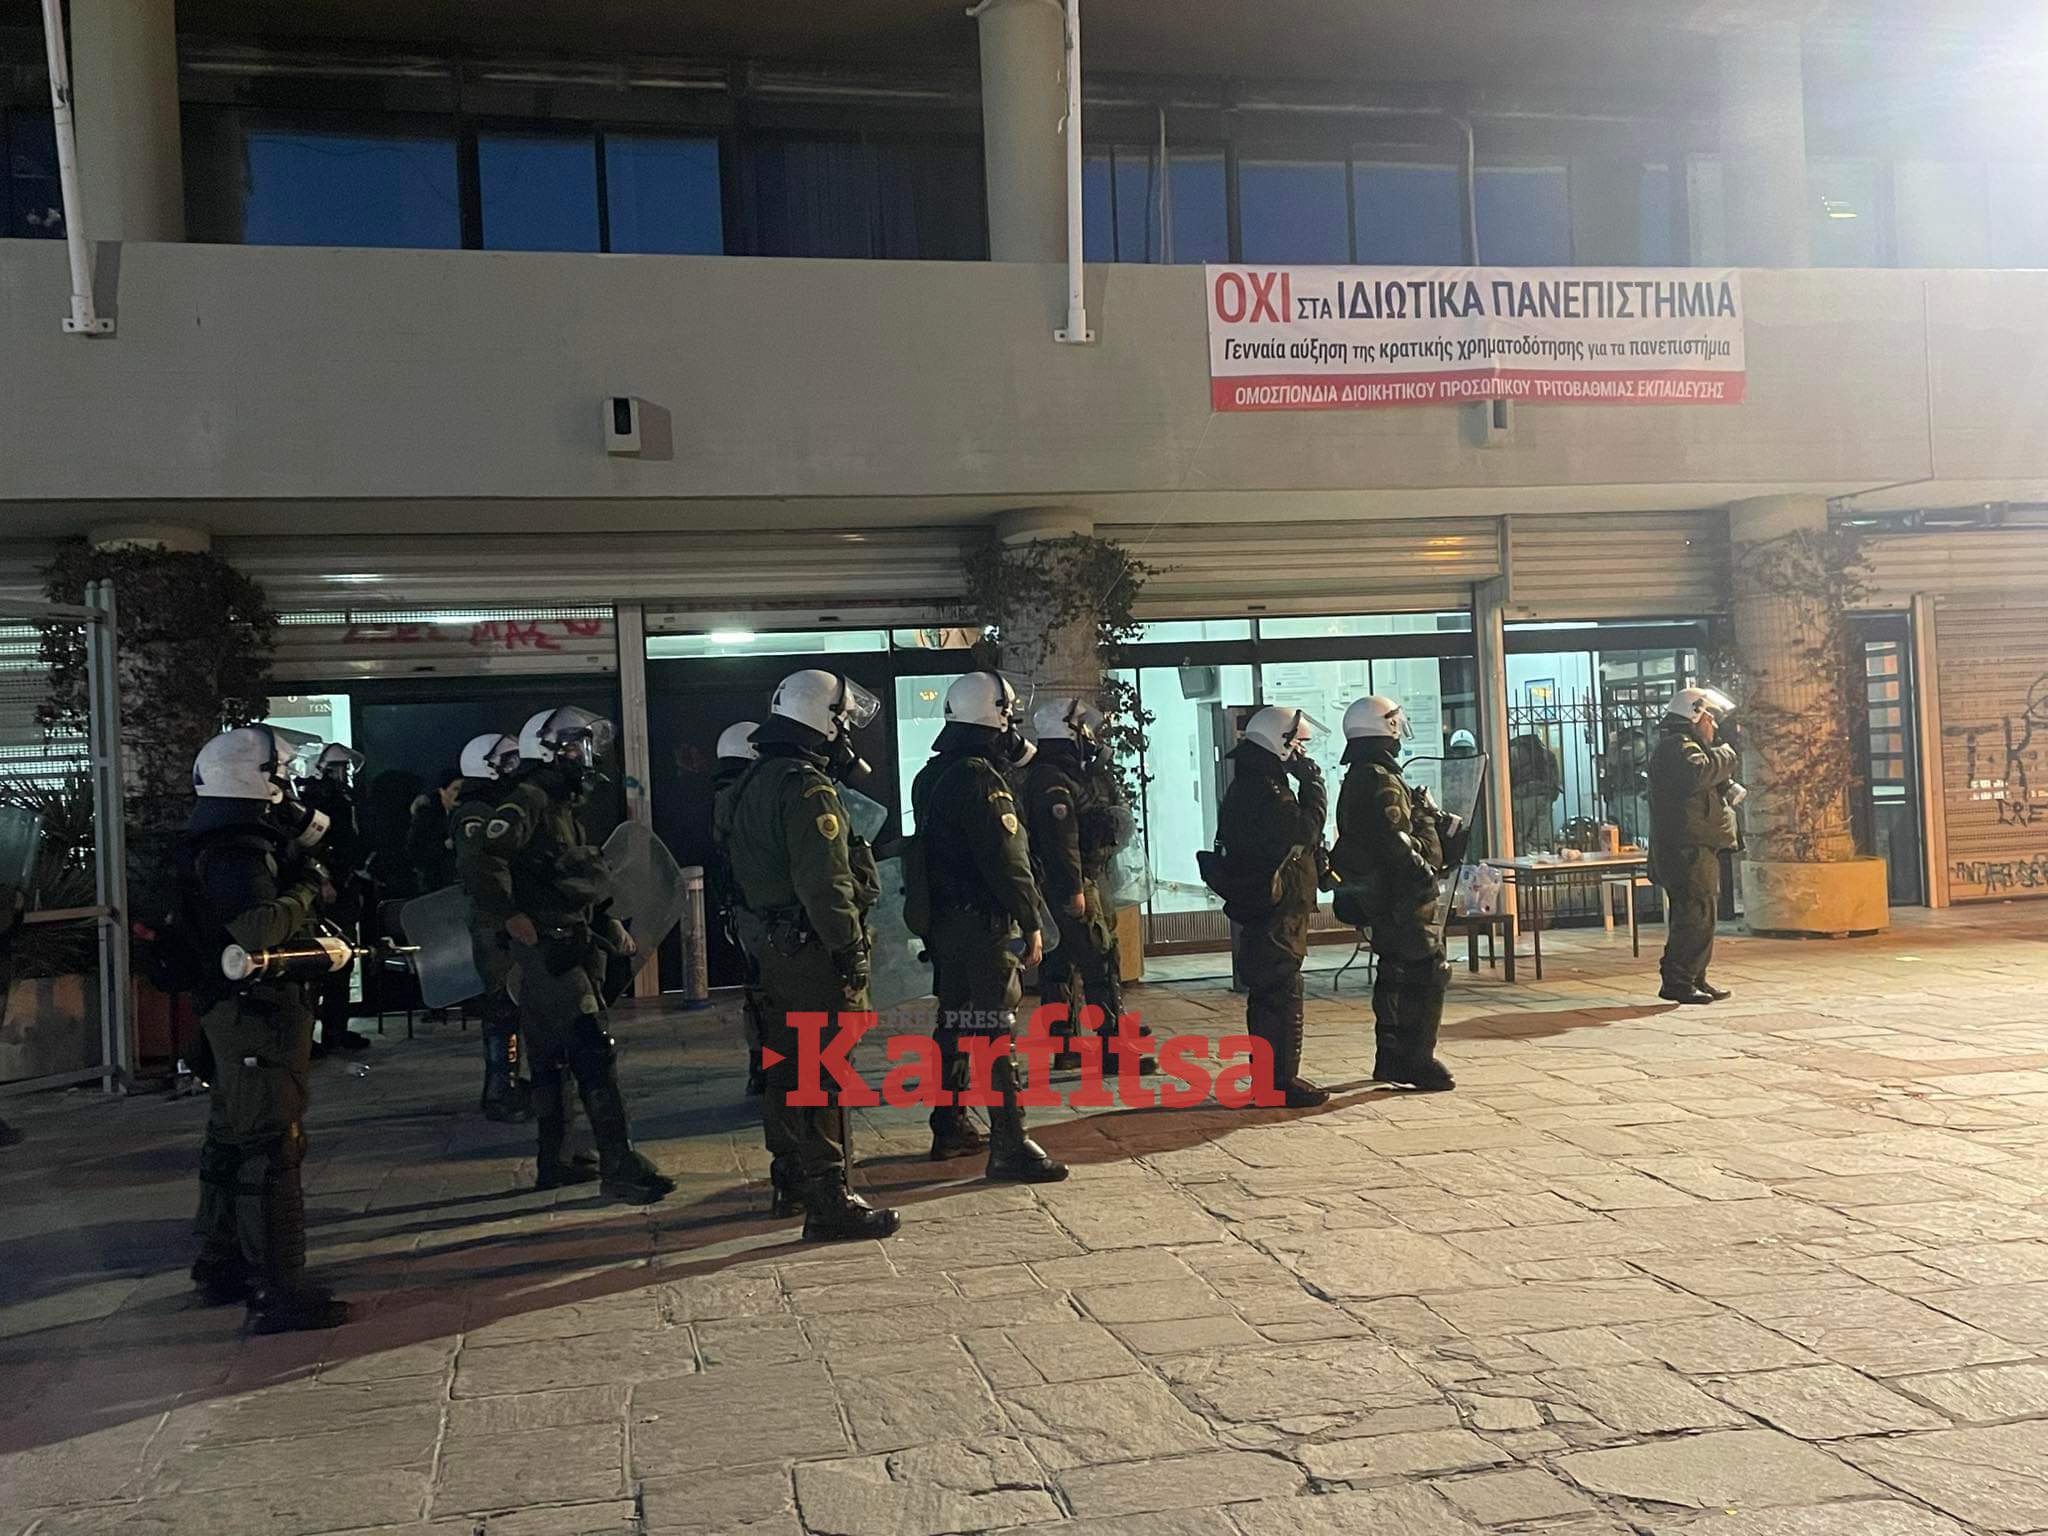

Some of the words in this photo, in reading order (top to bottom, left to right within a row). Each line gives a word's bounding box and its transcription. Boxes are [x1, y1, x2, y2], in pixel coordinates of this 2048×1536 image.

[1215, 271, 1292, 323] ΟΧΙ
[1297, 298, 1333, 319] ΣΤΑ
[1337, 280, 1485, 319] ΙΔΙΩΤΙΚΑ
[1491, 281, 1736, 318] ΠΑΝΕΠΙΣΤΗΜΙΑ
[1225, 338, 1286, 360] Γενναία
[1290, 338, 1347, 364] αύξηση
[1352, 344, 1375, 363] της
[1379, 336, 1453, 364] κρατικής
[1457, 335, 1584, 361] χρηματοδότησης
[1588, 342, 1607, 361] για
[1610, 342, 1625, 356] τα
[1629, 333, 1731, 360] πανεπιστήμια
[1235, 385, 1339, 405] ΟΜΟΣΠΟΝΔΙΑ
[1341, 382, 1435, 402] ΔΙΟΙΚΗΤΙΚΟΥ
[1439, 378, 1532, 399] ΠΡΟΣΩΠΙΚΟΥ
[1534, 379, 1635, 398] ΤΡΙΤΟΒΑΘΜΙΑΣ
[1637, 380, 1725, 399] ΕΚΠΑΙΔΕΥΣΗΣ
